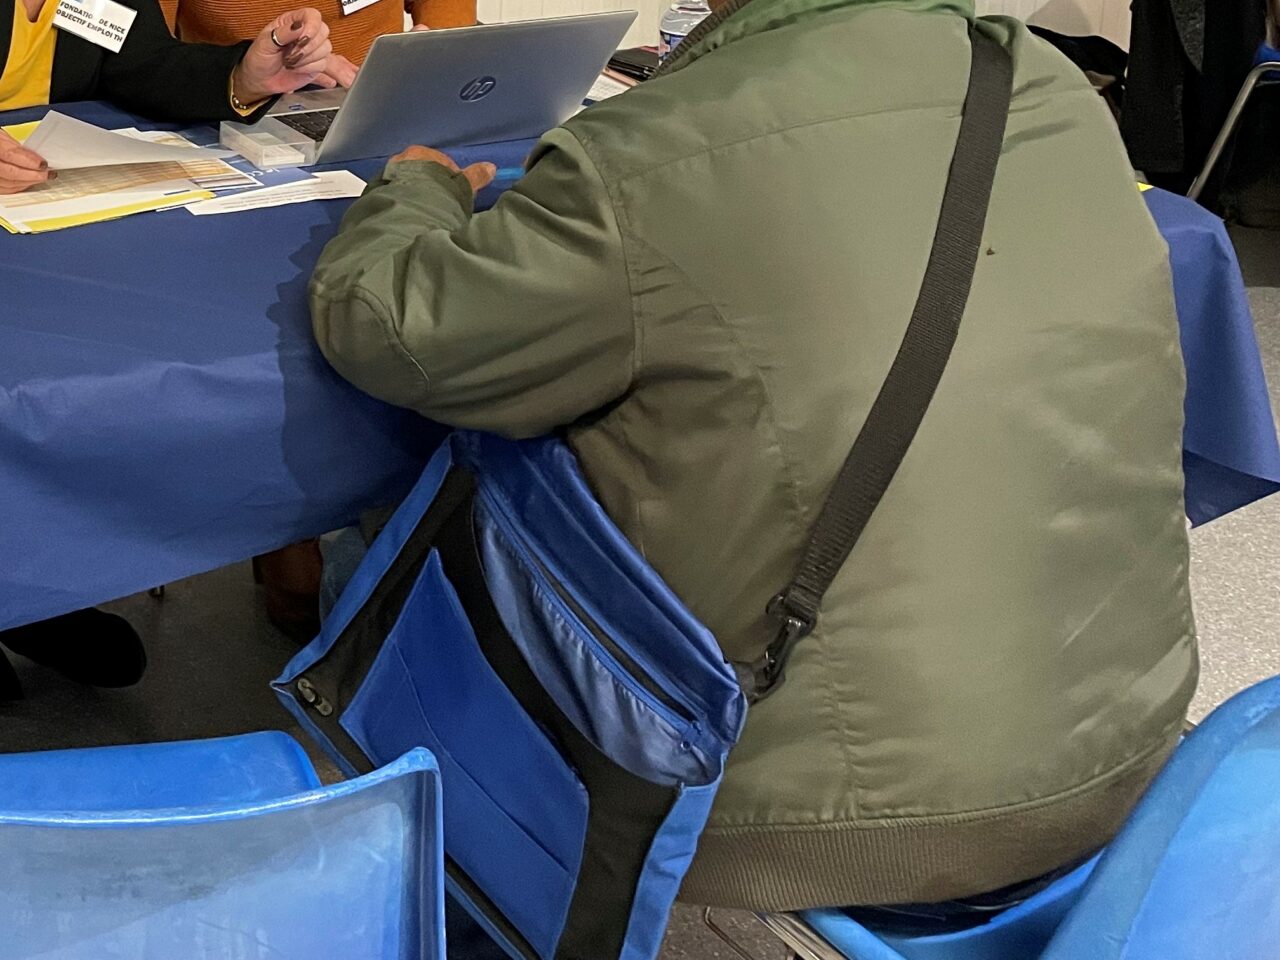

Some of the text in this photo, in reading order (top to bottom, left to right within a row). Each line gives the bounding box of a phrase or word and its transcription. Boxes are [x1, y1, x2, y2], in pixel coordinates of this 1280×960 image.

[56, 9, 87, 26] OBJECTIF
[114, 34, 123, 42] TH
[60, 1, 94, 19] FONDATIO
[109, 22, 126, 34] NICE
[461, 77, 495, 101] hp
